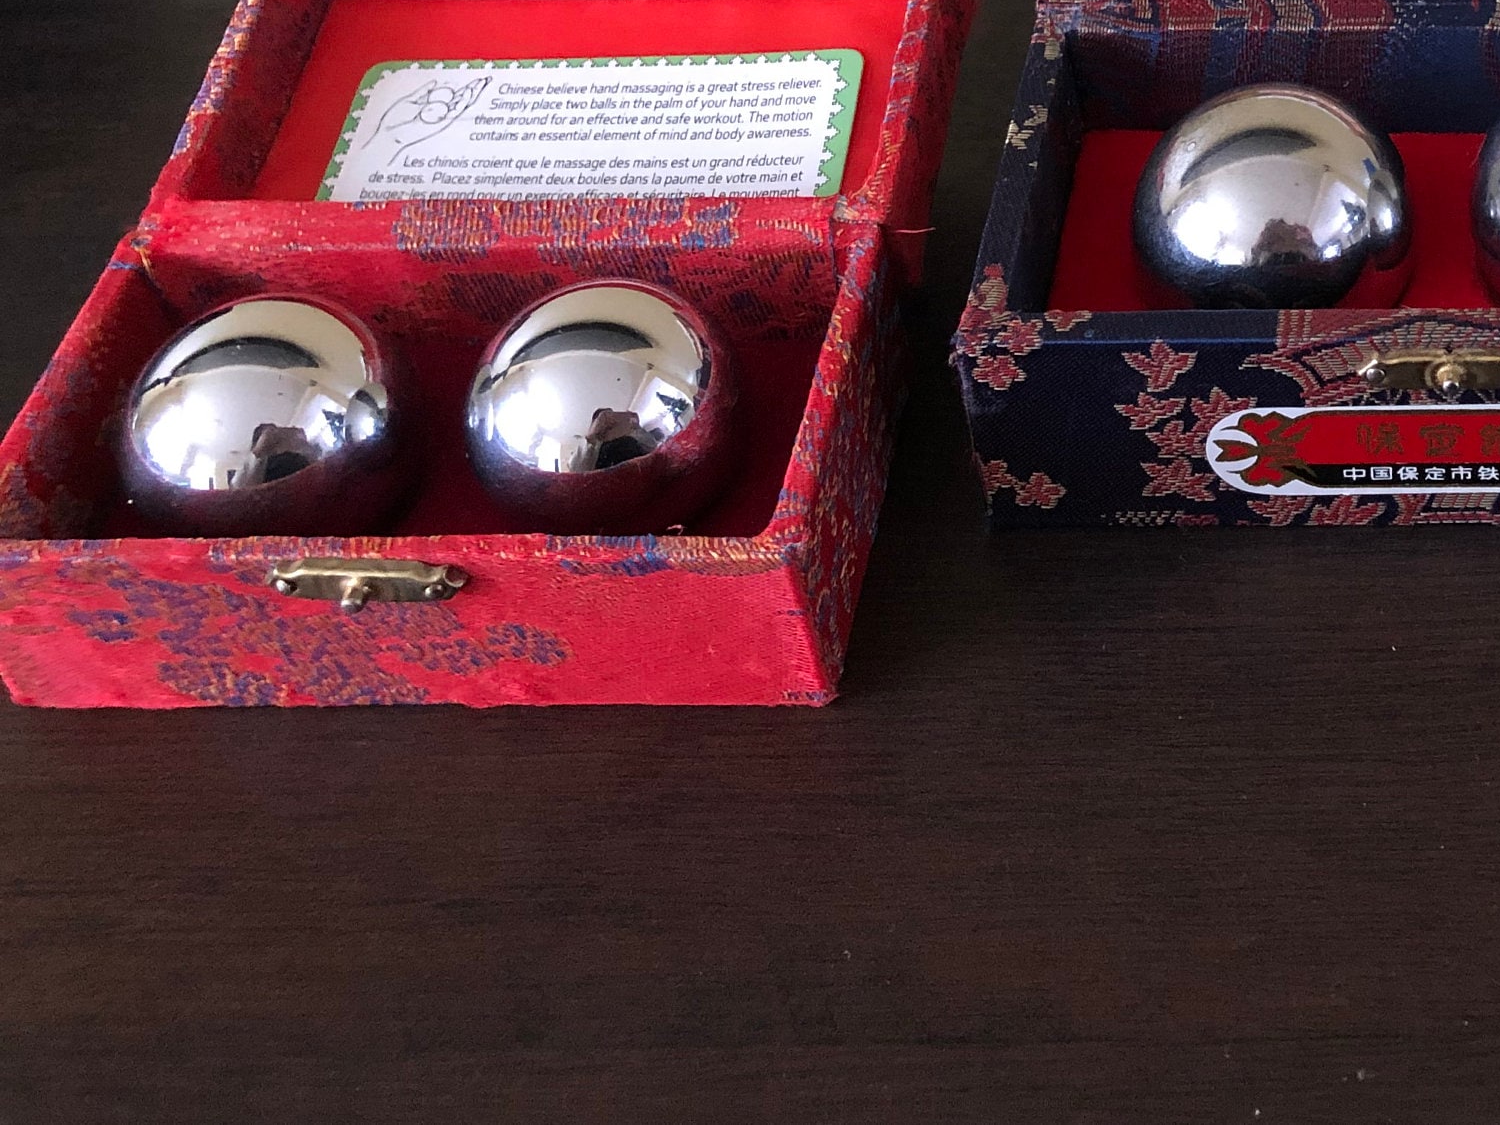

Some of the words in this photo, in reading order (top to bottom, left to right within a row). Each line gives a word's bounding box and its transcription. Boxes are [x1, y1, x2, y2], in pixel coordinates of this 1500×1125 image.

[498, 83, 543, 94] Chinese
[546, 82, 587, 94] believe
[590, 82, 618, 94] hand
[621, 81, 683, 96] massaging
[686, 81, 695, 92] is
[698, 84, 704, 92] a
[708, 80, 737, 95] great
[741, 80, 775, 91] stress
[778, 78, 822, 90] reliever.
[490, 99, 530, 111] Simply
[533, 99, 563, 111] place
[566, 100, 587, 109] two
[590, 97, 617, 109] balls
[619, 96, 630, 108] in
[632, 96, 652, 108] the
[654, 96, 682, 111] palm
[685, 95, 698, 108] of
[700, 98, 726, 111] your
[729, 95, 758, 107] hand
[761, 95, 781, 106] and
[785, 95, 816, 105] move
[475, 115, 503, 125] them
[506, 114, 547, 125] around
[550, 114, 572, 125] for
[575, 116, 584, 125] an
[587, 113, 638, 125] effective
[641, 113, 662, 124] and
[665, 112, 690, 124] safe
[694, 112, 744, 124] workout.
[749, 112, 769, 123] The
[773, 112, 813, 122] motion
[470, 130, 518, 141] contains
[521, 132, 536, 140] an
[538, 130, 590, 141] essential
[594, 129, 641, 140] element
[643, 128, 658, 140] of
[659, 128, 688, 140] mind
[690, 128, 712, 140] and
[715, 128, 744, 142] body
[747, 127, 812, 139] awareness.
[403, 157, 424, 167] Les
[428, 157, 469, 168] chinois
[472, 157, 513, 168] croient
[516, 159, 537, 170] que
[540, 156, 551, 167] le
[554, 158, 606, 171] massage
[609, 157, 630, 168] des
[633, 157, 667, 168] mains
[671, 157, 690, 167] est
[692, 158, 706, 167] un
[709, 155, 744, 170] grand
[746, 155, 803, 166] réducteur
[368, 174, 384, 183] de
[387, 174, 424, 183] stress.
[432, 173, 470, 184] Placez
[474, 174, 543, 187] simplement
[546, 174, 575, 185] deux
[577, 173, 617, 185] boules
[620, 174, 648, 184] dans
[651, 173, 662, 184] la
[664, 175, 704, 186] paume
[708, 173, 722, 184] de
[726, 173, 756, 183] votre
[759, 172, 787, 182] main
[790, 171, 803, 181] et
